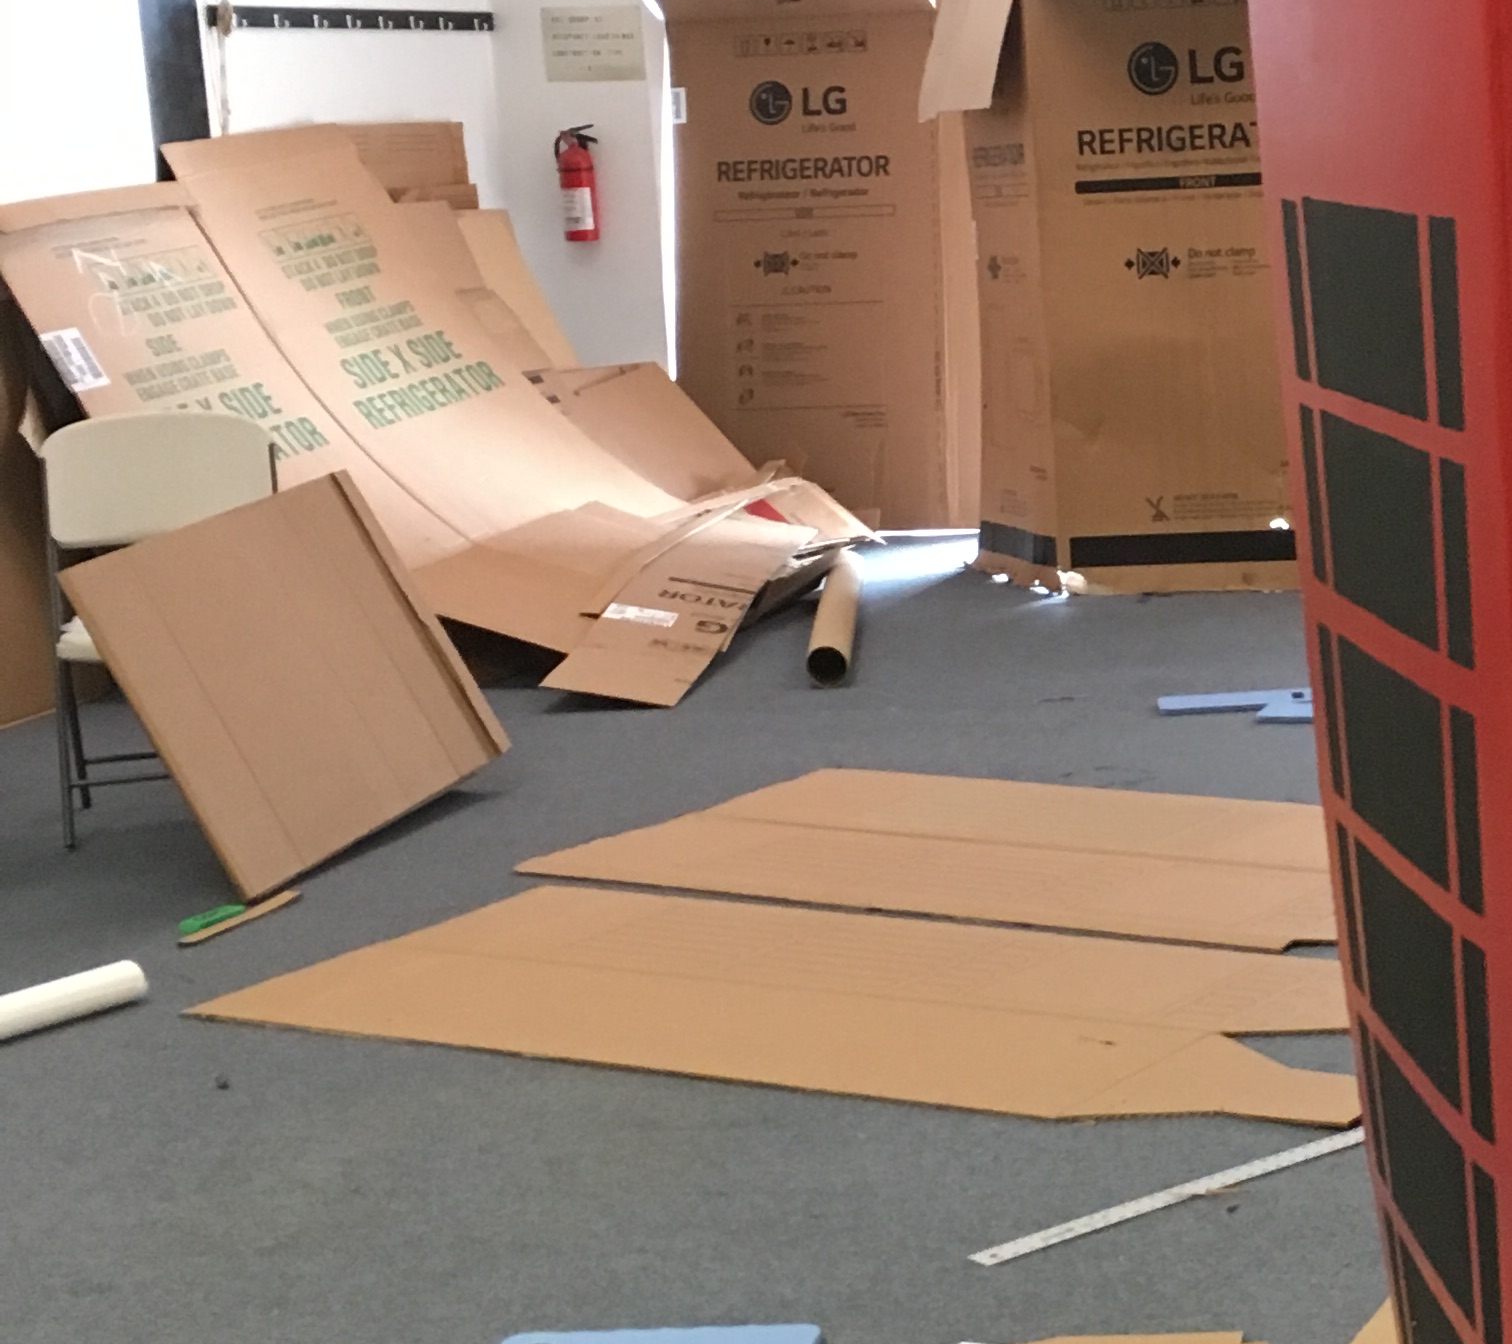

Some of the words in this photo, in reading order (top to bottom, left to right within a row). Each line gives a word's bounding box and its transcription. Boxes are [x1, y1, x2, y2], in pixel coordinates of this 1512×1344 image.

[1188, 46, 1245, 84] LG
[801, 86, 847, 116] LG
[717, 155, 890, 183] REFRIGERATOR
[1188, 248, 1203, 258] Do
[1205, 248, 1222, 258] not
[1225, 247, 1256, 260] clamp
[339, 349, 399, 389] SIDE
[386, 343, 417, 375] X
[405, 330, 463, 369] SIDE
[218, 382, 282, 419] SIDE
[352, 361, 505, 430] REFRIGERATOR
